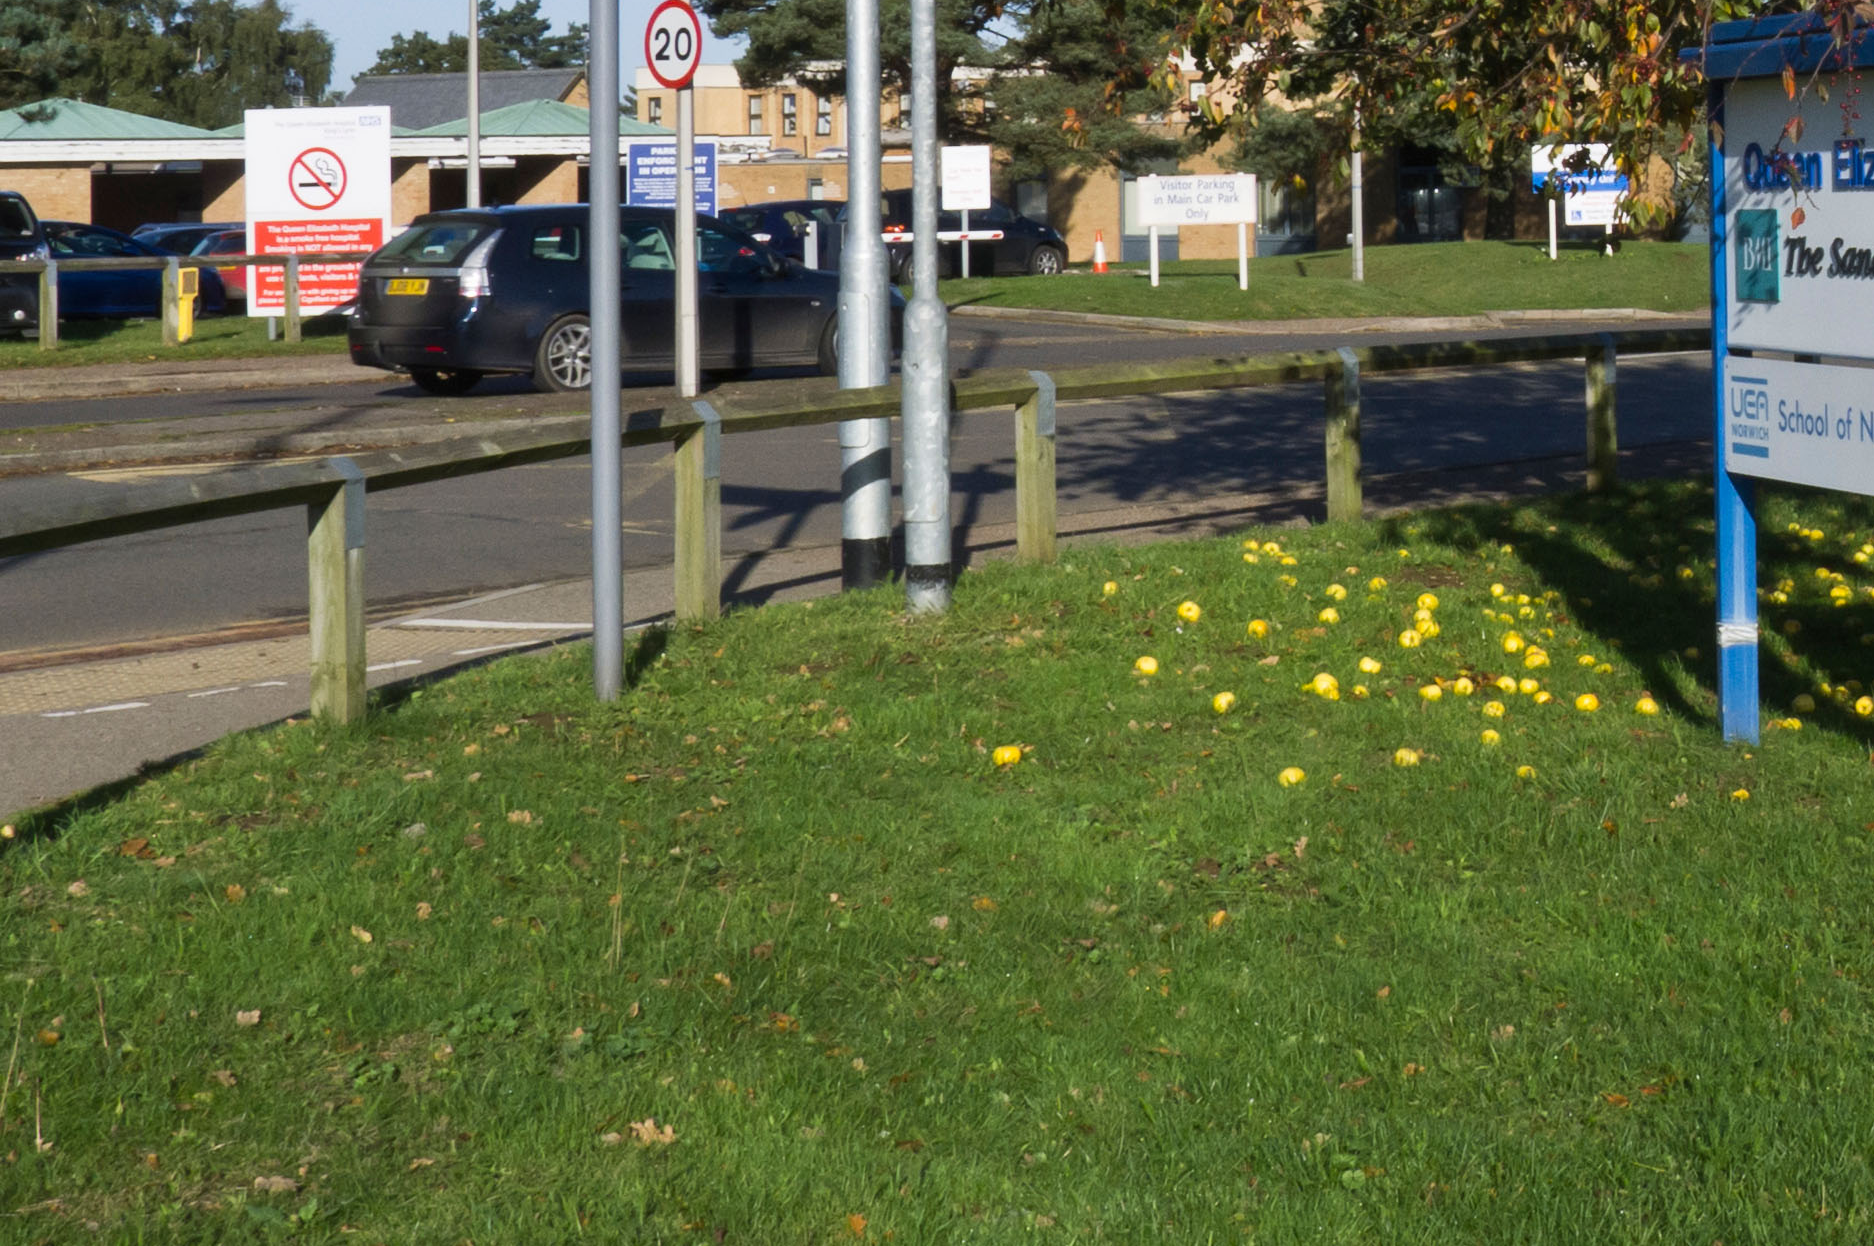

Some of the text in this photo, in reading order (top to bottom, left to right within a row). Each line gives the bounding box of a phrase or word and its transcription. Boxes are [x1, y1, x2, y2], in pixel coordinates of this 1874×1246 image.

[655, 27, 692, 61] 20
[1160, 179, 1235, 192] Visitor Parking
[1154, 193, 1240, 204] in Main Car Park
[1185, 208, 1209, 221] Only
[1742, 236, 1773, 272] BMI
[1783, 236, 1822, 277] The
[1731, 385, 1769, 422] UEA
[1778, 399, 1829, 437] School
[1836, 406, 1853, 441] of
[1731, 423, 1769, 442] NORWICH
